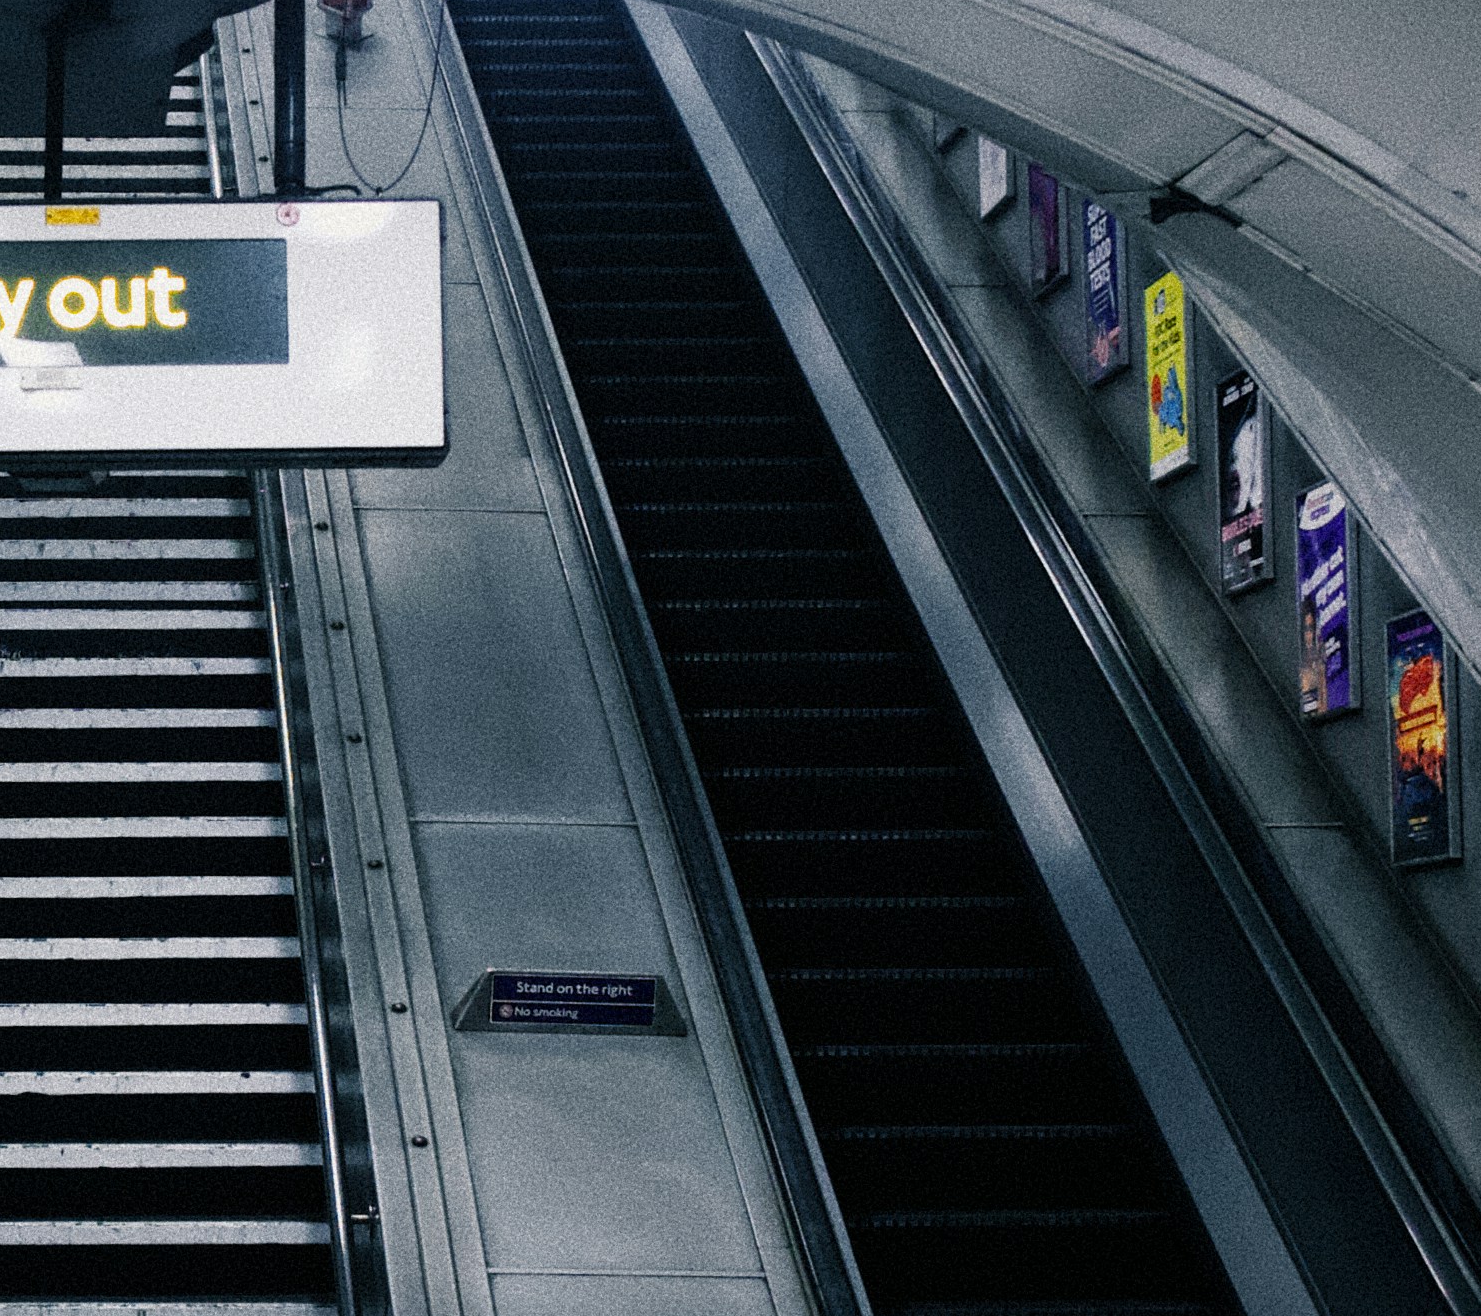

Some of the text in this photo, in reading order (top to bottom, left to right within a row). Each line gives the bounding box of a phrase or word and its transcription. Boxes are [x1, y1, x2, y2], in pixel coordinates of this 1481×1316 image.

[45, 264, 189, 332] out
[515, 981, 634, 999] Stand on the right
[514, 1006, 580, 1020] No smoking
